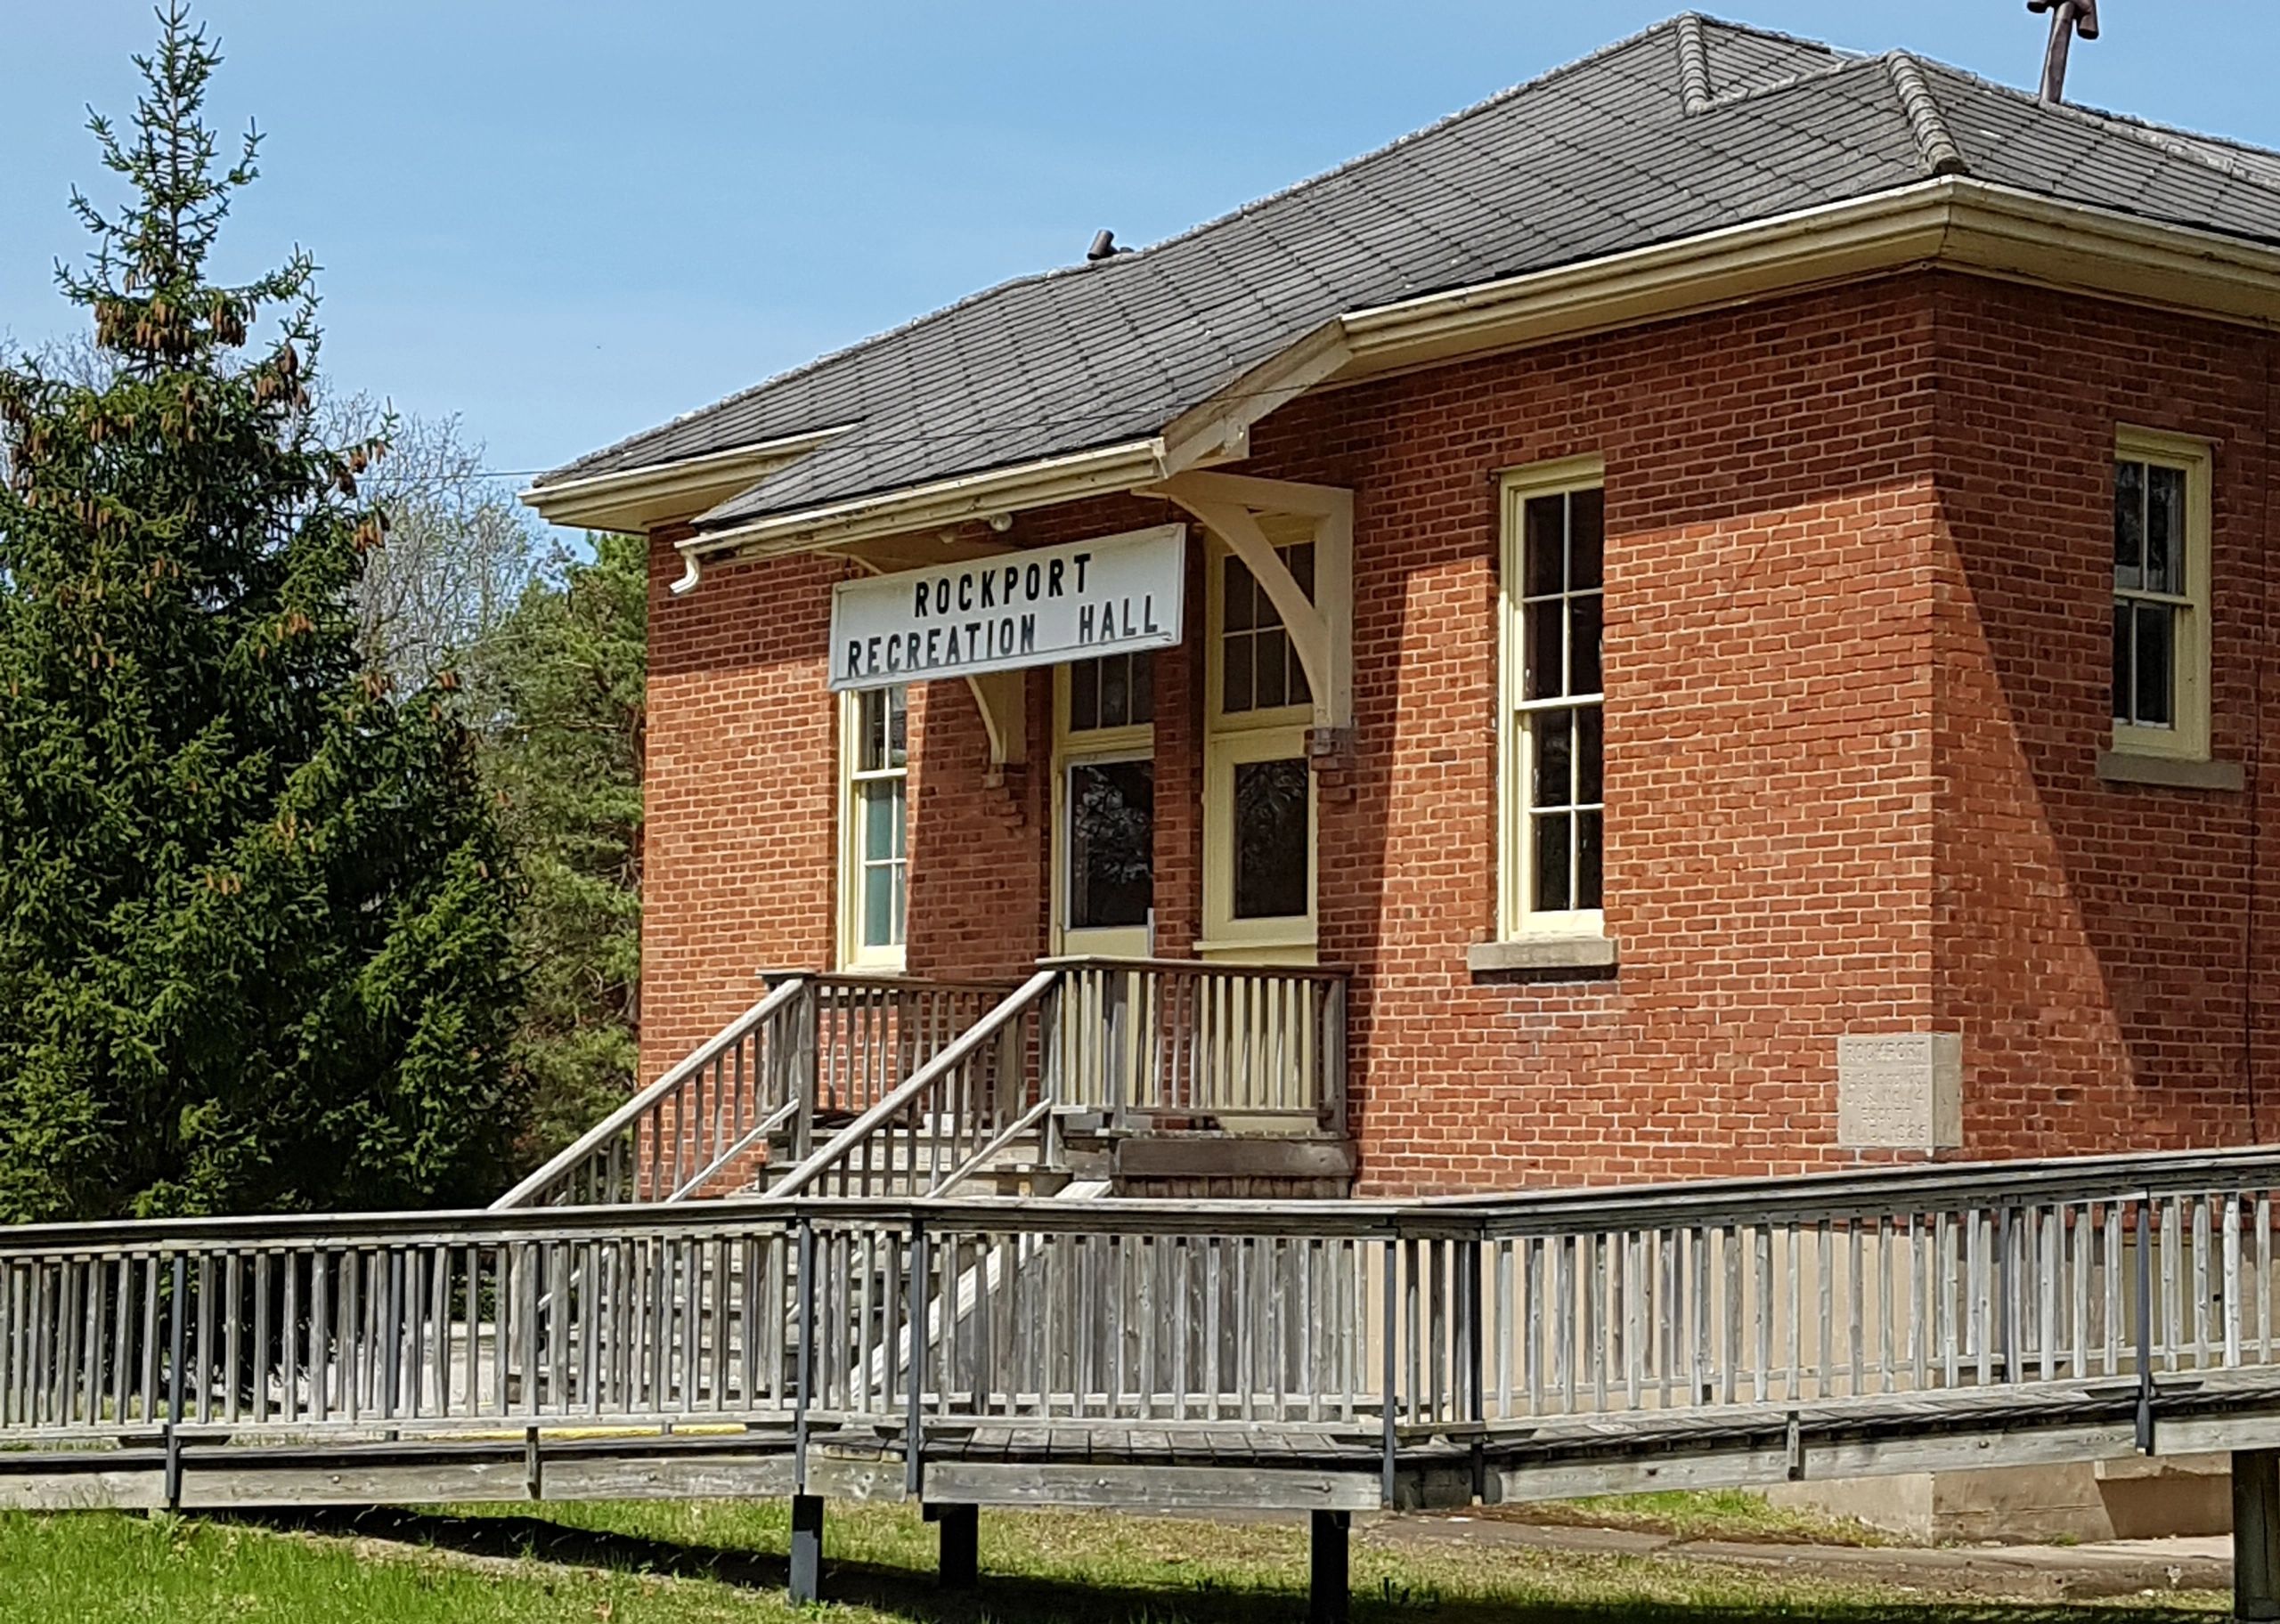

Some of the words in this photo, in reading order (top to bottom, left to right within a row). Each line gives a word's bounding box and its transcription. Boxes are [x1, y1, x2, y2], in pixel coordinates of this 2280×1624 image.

[915, 553, 1091, 618] ROCKPORT
[848, 613, 1036, 678] RECREATION
[1079, 595, 1159, 644] HALL
